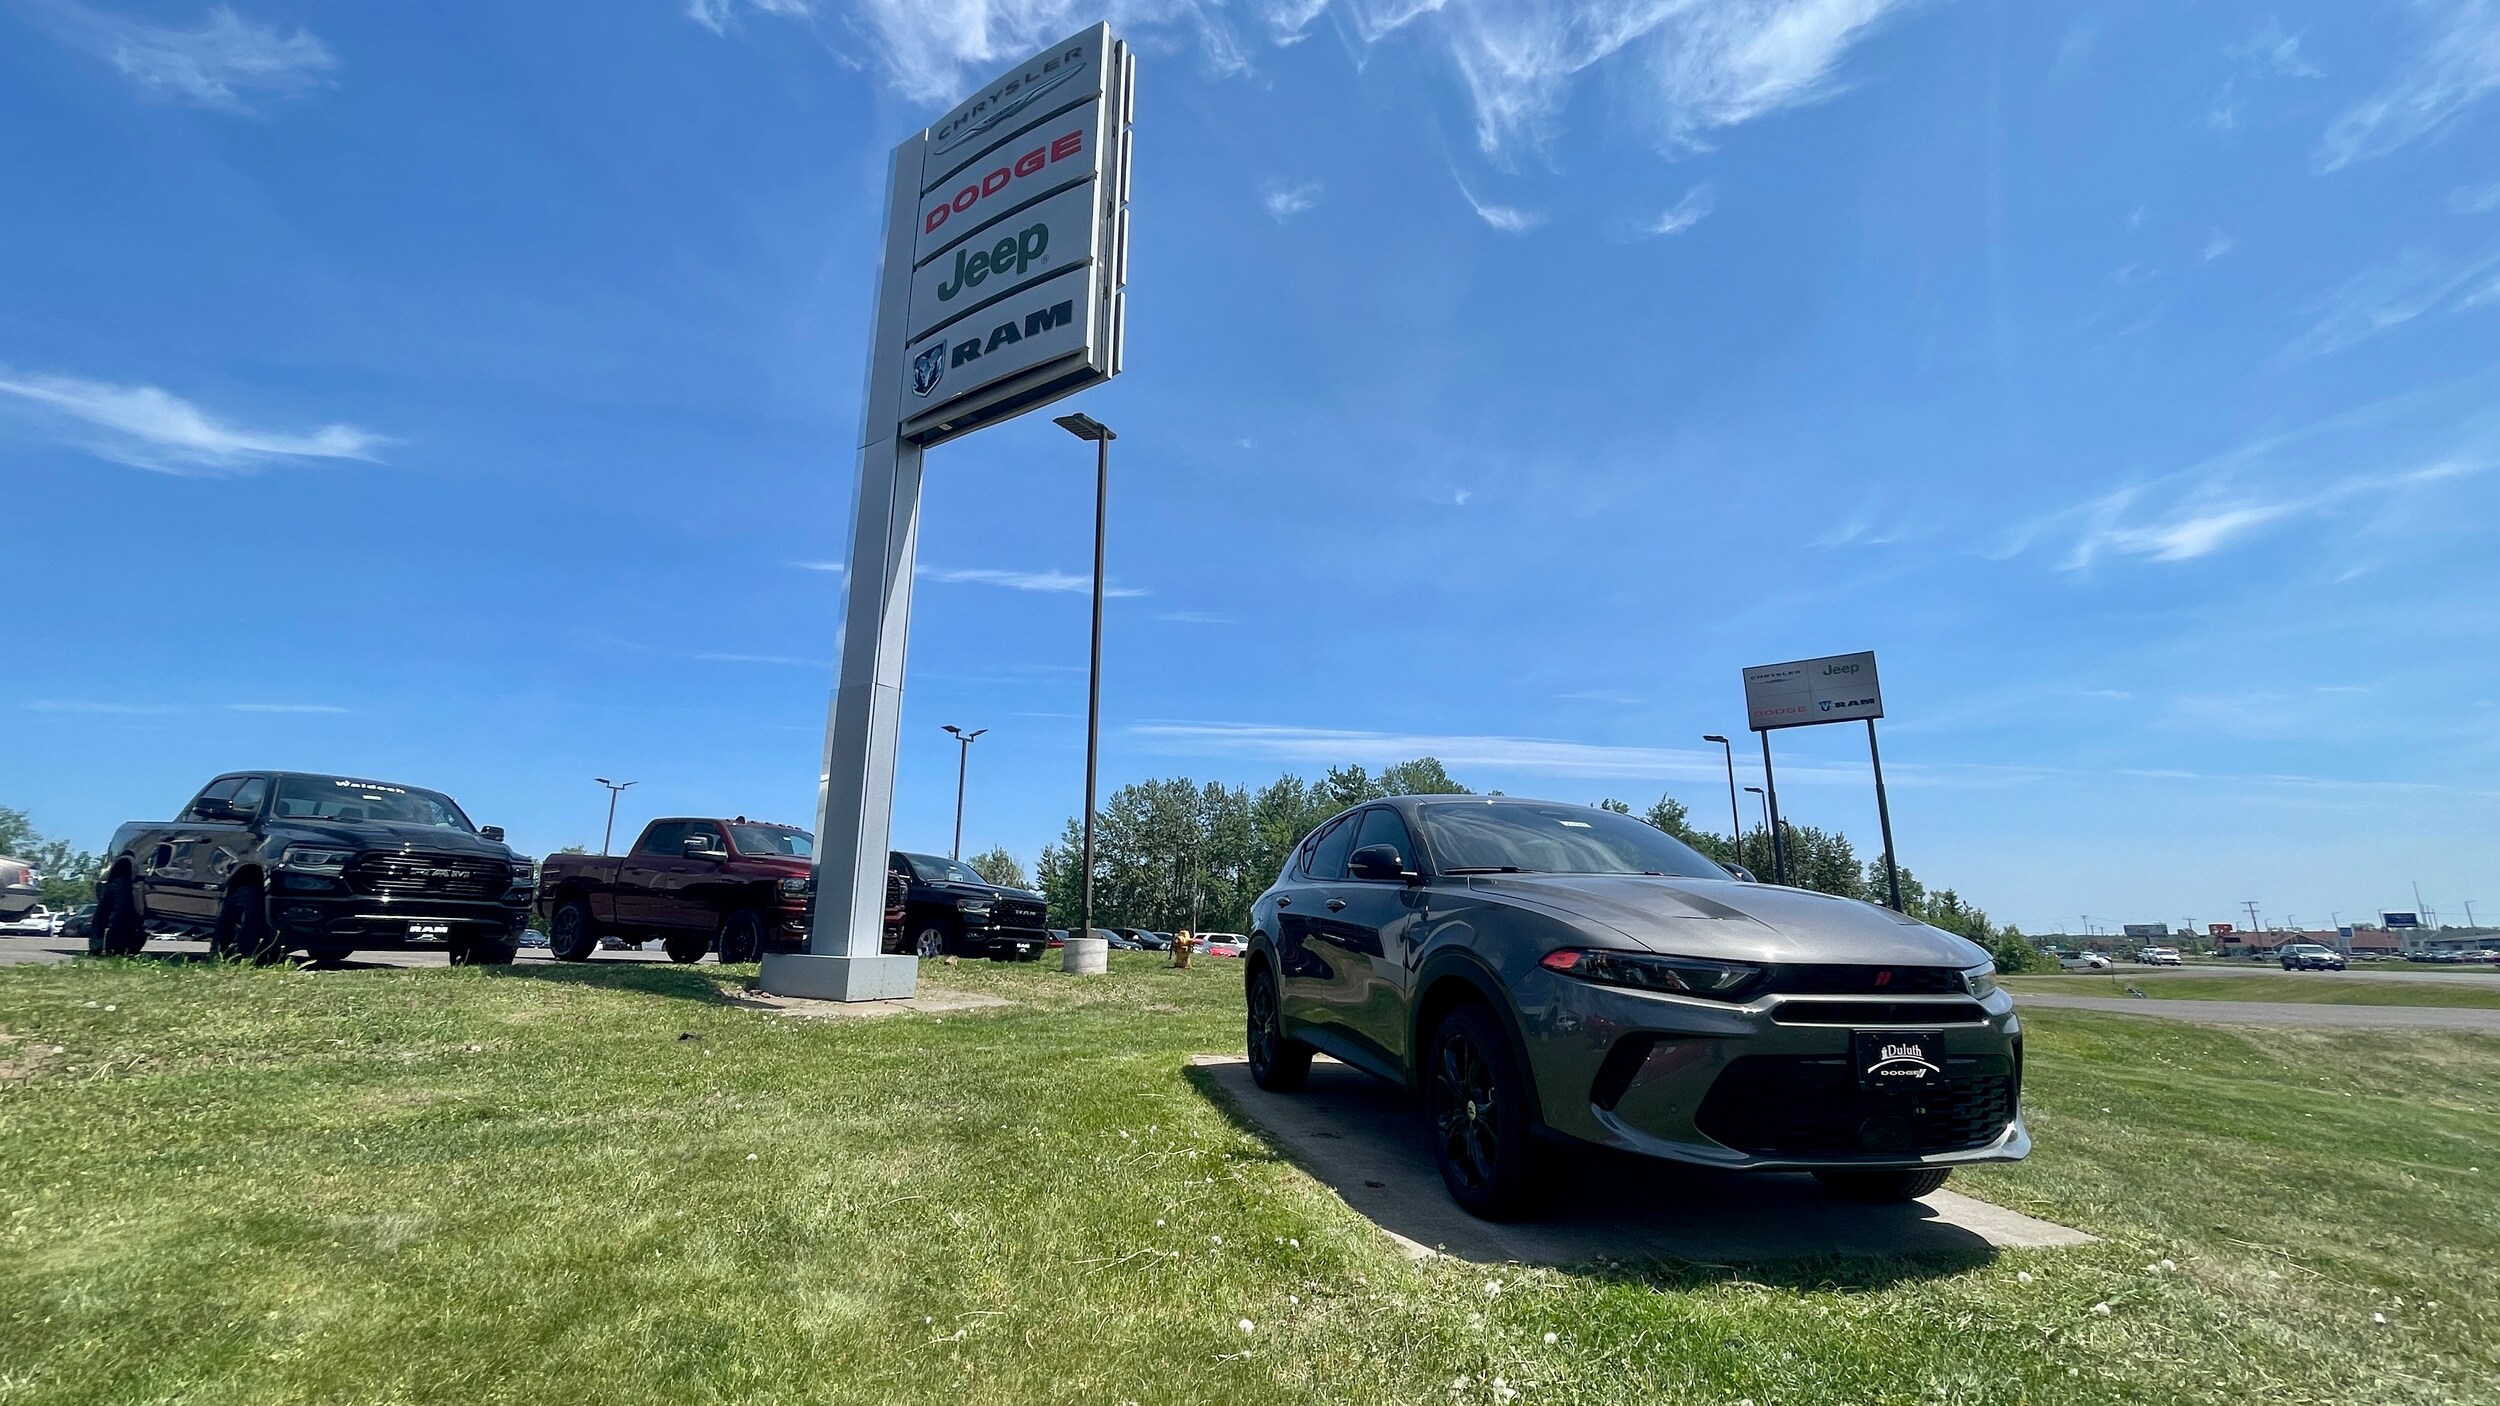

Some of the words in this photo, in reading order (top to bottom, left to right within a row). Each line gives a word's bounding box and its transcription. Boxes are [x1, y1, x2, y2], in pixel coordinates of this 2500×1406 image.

[937, 46, 1083, 142] CHRYSLER
[925, 129, 1083, 235] DODGE
[937, 222, 1049, 302] Jeep
[951, 299, 1073, 369] RAM
[1750, 670, 1801, 680] CHRYSLER
[1822, 663, 1860, 676] Jeep
[1834, 698, 1875, 708] RAM
[1753, 704, 1807, 717] DODGE
[409, 867, 471, 878] RAM
[409, 925, 449, 933] RAM
[1886, 1043, 1923, 1057] Duluth
